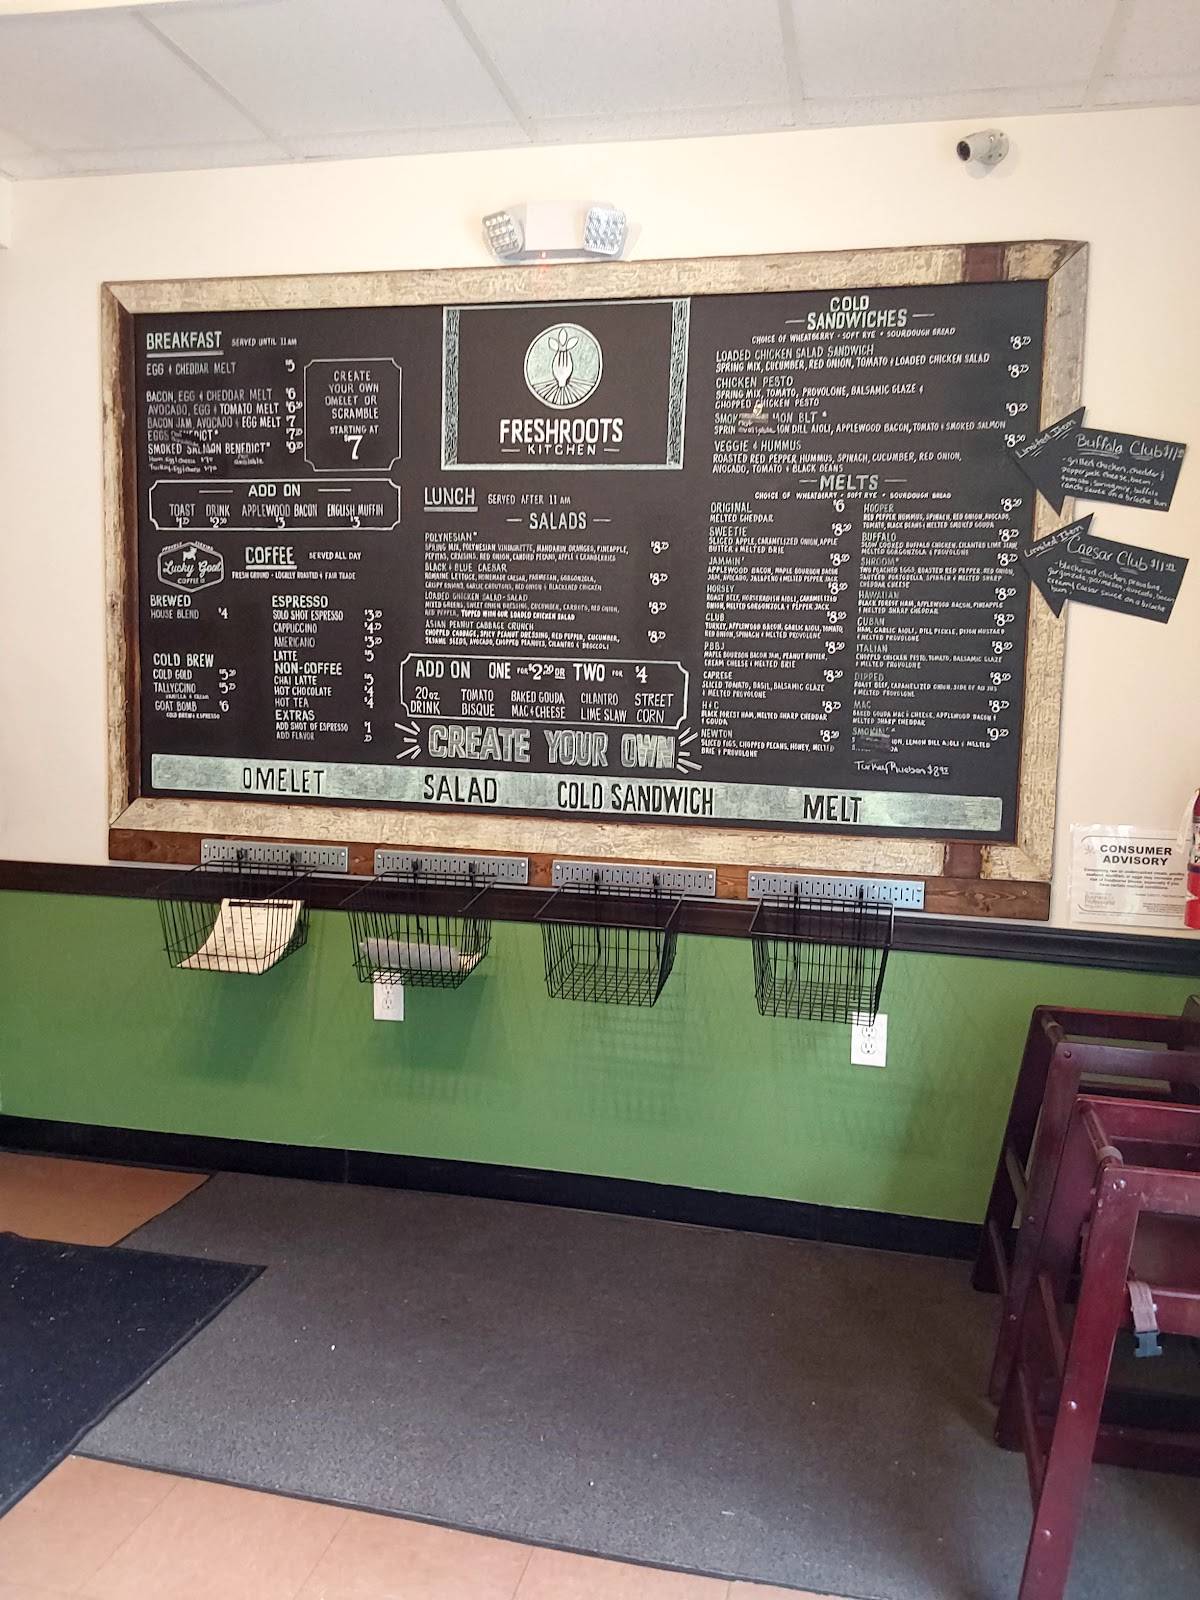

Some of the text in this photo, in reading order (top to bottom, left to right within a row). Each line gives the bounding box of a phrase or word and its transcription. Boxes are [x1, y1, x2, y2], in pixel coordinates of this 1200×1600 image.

[830, 295, 870, 312] COLD
[806, 308, 908, 331] SANDWICHES
[146, 331, 222, 350] BREAKFAST
[231, 338, 277, 347] SERVED UNTIL
[752, 334, 786, 344] CHOICE OF
[716, 344, 874, 362] LOADED CHICKEN SALAD SANDWICH
[146, 362, 236, 376] EGG CHEDDAR MELT
[285, 359, 296, 372] $5
[715, 353, 990, 373] SPRING MIX, CUCUMBER, RED ONION, TOMATO LOADED CHICKEN SALAD
[334, 370, 371, 381] CREATE
[716, 375, 793, 389] CHICKEN PESTO
[285, 387, 296, 400] $6
[328, 383, 379, 394] YOUR OWN
[766, 384, 916, 398] TOMATO, PROVOLONE, BALSAMIC GLAZE
[146, 388, 272, 403] BACON, EGG CHEDDAR MELT
[325, 395, 377, 406] OMELET OR
[220, 402, 279, 415] TOMATO MELT
[331, 408, 379, 420] SCRAMBLE
[242, 416, 281, 428] EGG MELT
[286, 415, 296, 428] $7
[330, 425, 379, 434] STARTING AT
[499, 418, 624, 443] FRESHROOTS
[344, 433, 364, 460] $7
[527, 444, 596, 456] KITCHEN
[714, 440, 801, 452] VEGGIE HUMMUS
[1075, 434, 1163, 458] Buffalo Club
[750, 454, 796, 463] RED PEPPER
[819, 474, 879, 491] MELTS
[249, 483, 301, 497] ADD ON
[424, 487, 476, 506] LUNCH
[488, 494, 516, 505] SERVED
[520, 494, 544, 505] AFTER
[832, 499, 845, 513] $6
[169, 504, 383, 517] TOAST DRINK APPLEWOOD BACON ENGLISH MUFFIN
[710, 501, 752, 513] ORIGINAL
[529, 511, 587, 530] SALADS
[245, 546, 295, 565] COFFEE
[309, 552, 362, 561] SERVED ALL DAY
[1066, 536, 1148, 571] Caesar Club
[163, 560, 222, 579] Lucky Goat
[150, 594, 191, 608] BREWED
[272, 595, 328, 608] ESPRESSO
[150, 608, 200, 620] HOUSE BLEND
[218, 607, 228, 620] $4
[272, 609, 344, 621] SOLO SHOT ESPRESSO
[705, 613, 724, 621] CLUB
[273, 622, 318, 634] CAPPUCCINO
[426, 620, 534, 631] ASIAN PEANUT CABBAGE CRUNCH
[856, 644, 888, 653] ITALIAN
[153, 653, 214, 668] COLD BREW
[273, 650, 298, 661] LATTE
[153, 669, 193, 681] COLD GOLD
[275, 662, 343, 676] NON-COFFEE
[415, 660, 511, 680] ADD ON ONE
[554, 663, 648, 684] OR TWO $4
[274, 676, 317, 686] CHAI LATTE
[274, 687, 332, 697] HOT CHOCOLATE
[461, 688, 494, 701] TOMATO
[511, 690, 565, 705] BAKED GOUDA
[580, 692, 619, 705] CILANTRO
[155, 700, 197, 712] GOAT BOMB
[219, 700, 229, 712] $6
[274, 698, 309, 708] HOT TEA
[634, 693, 674, 708] STREET
[410, 701, 441, 715] DRINK
[461, 703, 495, 717] BISQUE
[275, 710, 315, 721] EXTRAS
[580, 708, 627, 723] LIME SLAW
[636, 709, 665, 723] CORN
[275, 722, 349, 732] ADD SHOT OF ESPRESSO
[701, 729, 733, 738] NEWTON
[428, 724, 676, 769] CREATE YOUR OWN
[243, 767, 325, 794] OMELET
[423, 774, 498, 804] SALAD
[557, 780, 714, 816] COLD SANDWICH
[802, 793, 862, 823] MELT
[1100, 844, 1172, 856] CONSUMER
[1103, 855, 1168, 866] ADVISORY
